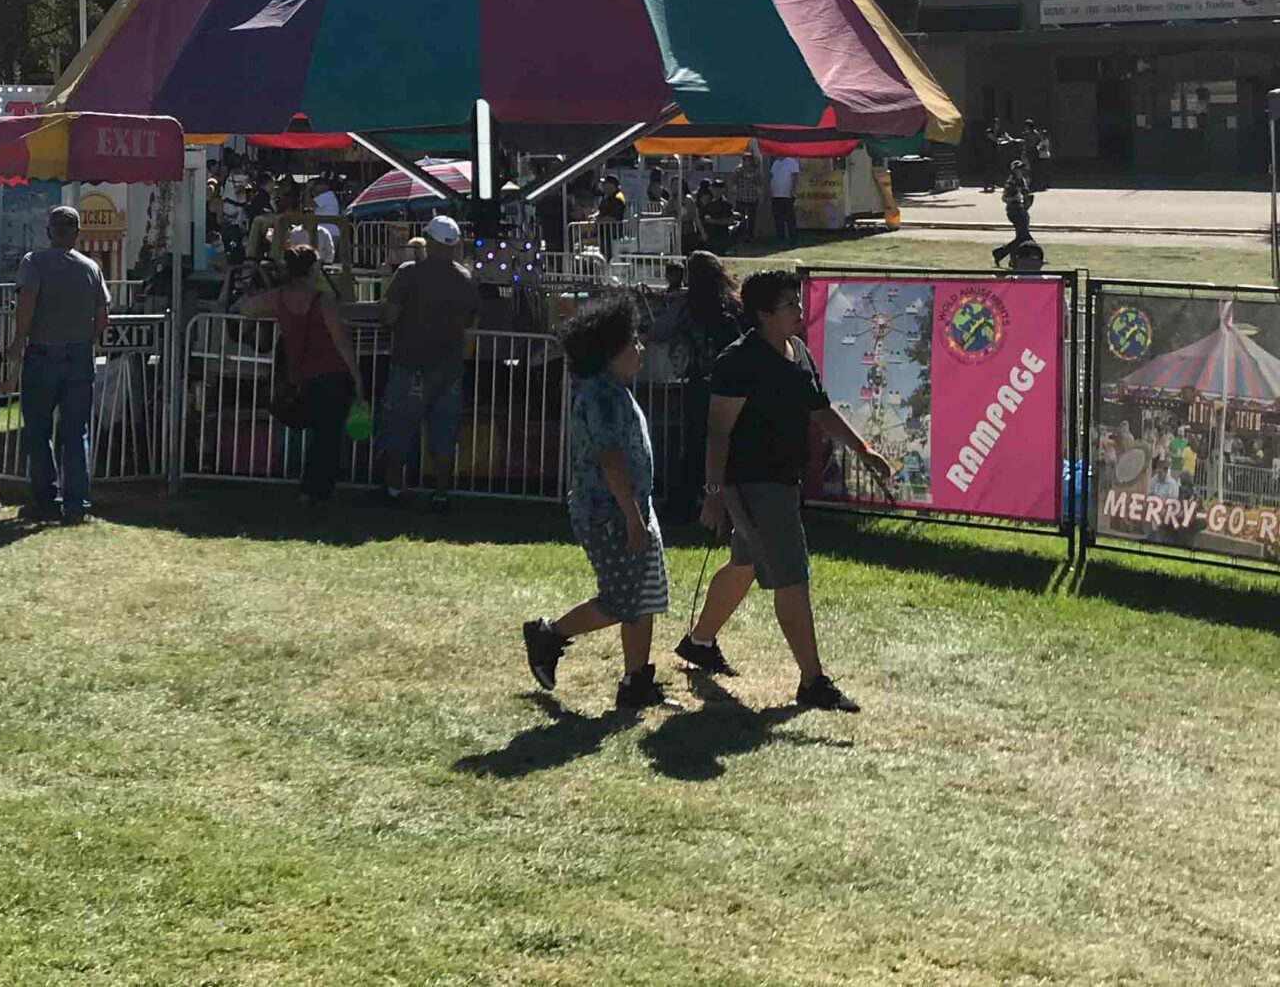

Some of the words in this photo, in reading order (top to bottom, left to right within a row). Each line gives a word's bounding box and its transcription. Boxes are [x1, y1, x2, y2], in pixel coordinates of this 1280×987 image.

[96, 127, 160, 158] EXIT
[102, 325, 151, 346] EXIT
[946, 348, 1046, 492] RAMPAGE
[1103, 489, 1280, 544] MERRY-GO-R
